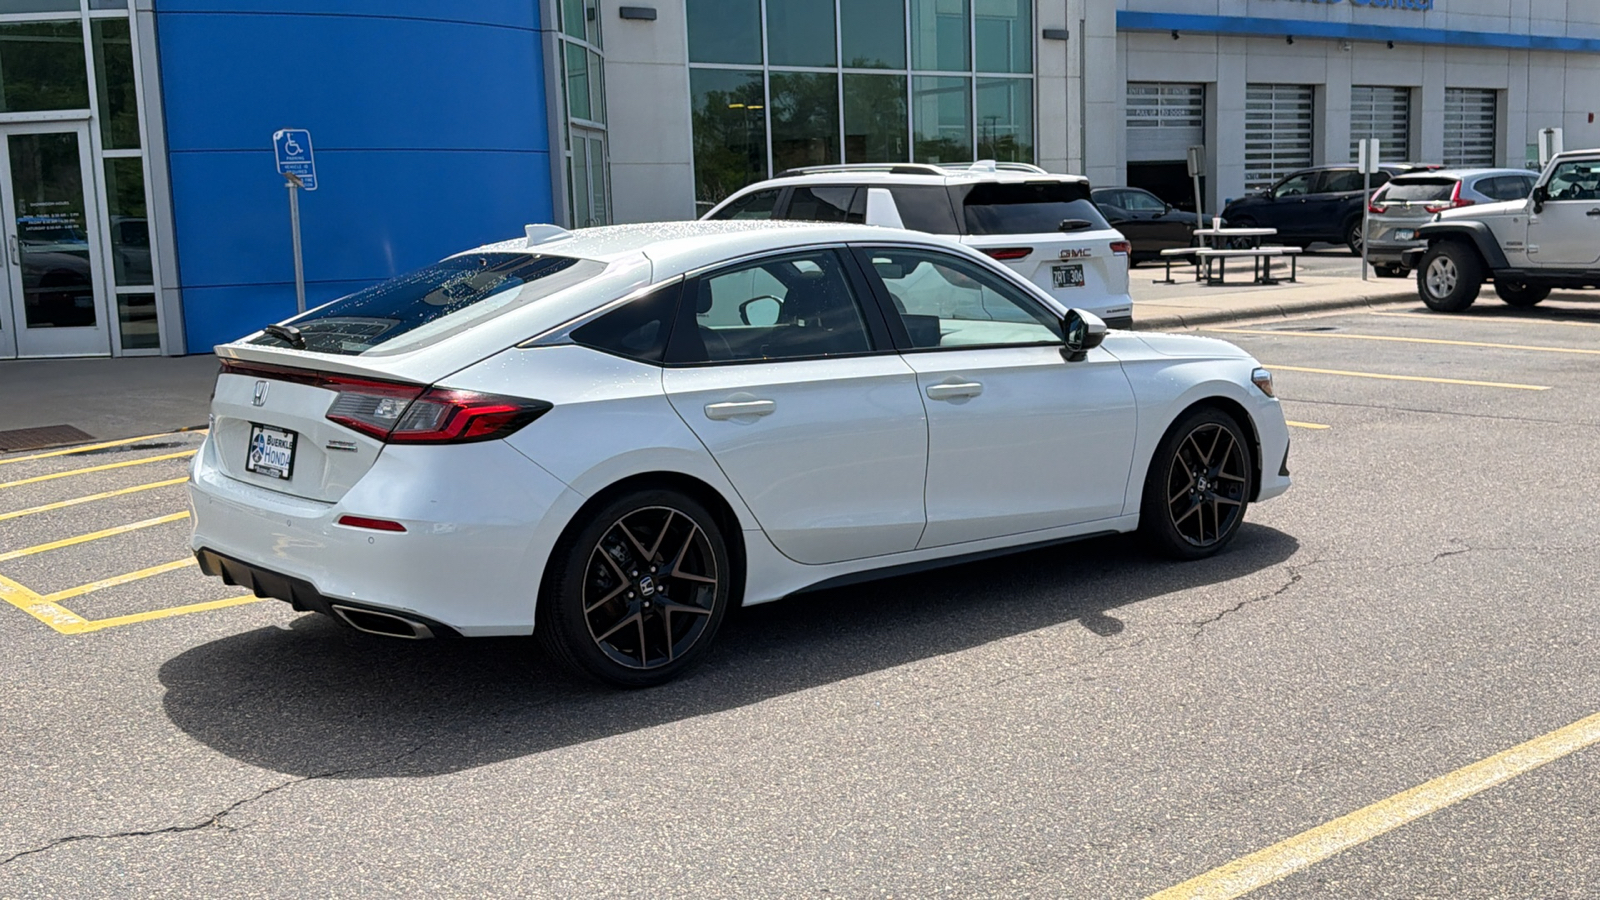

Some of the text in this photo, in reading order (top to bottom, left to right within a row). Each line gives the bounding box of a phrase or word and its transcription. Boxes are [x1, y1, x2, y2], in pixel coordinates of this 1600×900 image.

[1349, 0, 1433, 10] enter
[1060, 248, 1092, 258] GMC
[1053, 269, 1083, 284] ZRT 306
[266, 434, 293, 450] BUERKLE
[264, 445, 291, 467] HONDA
